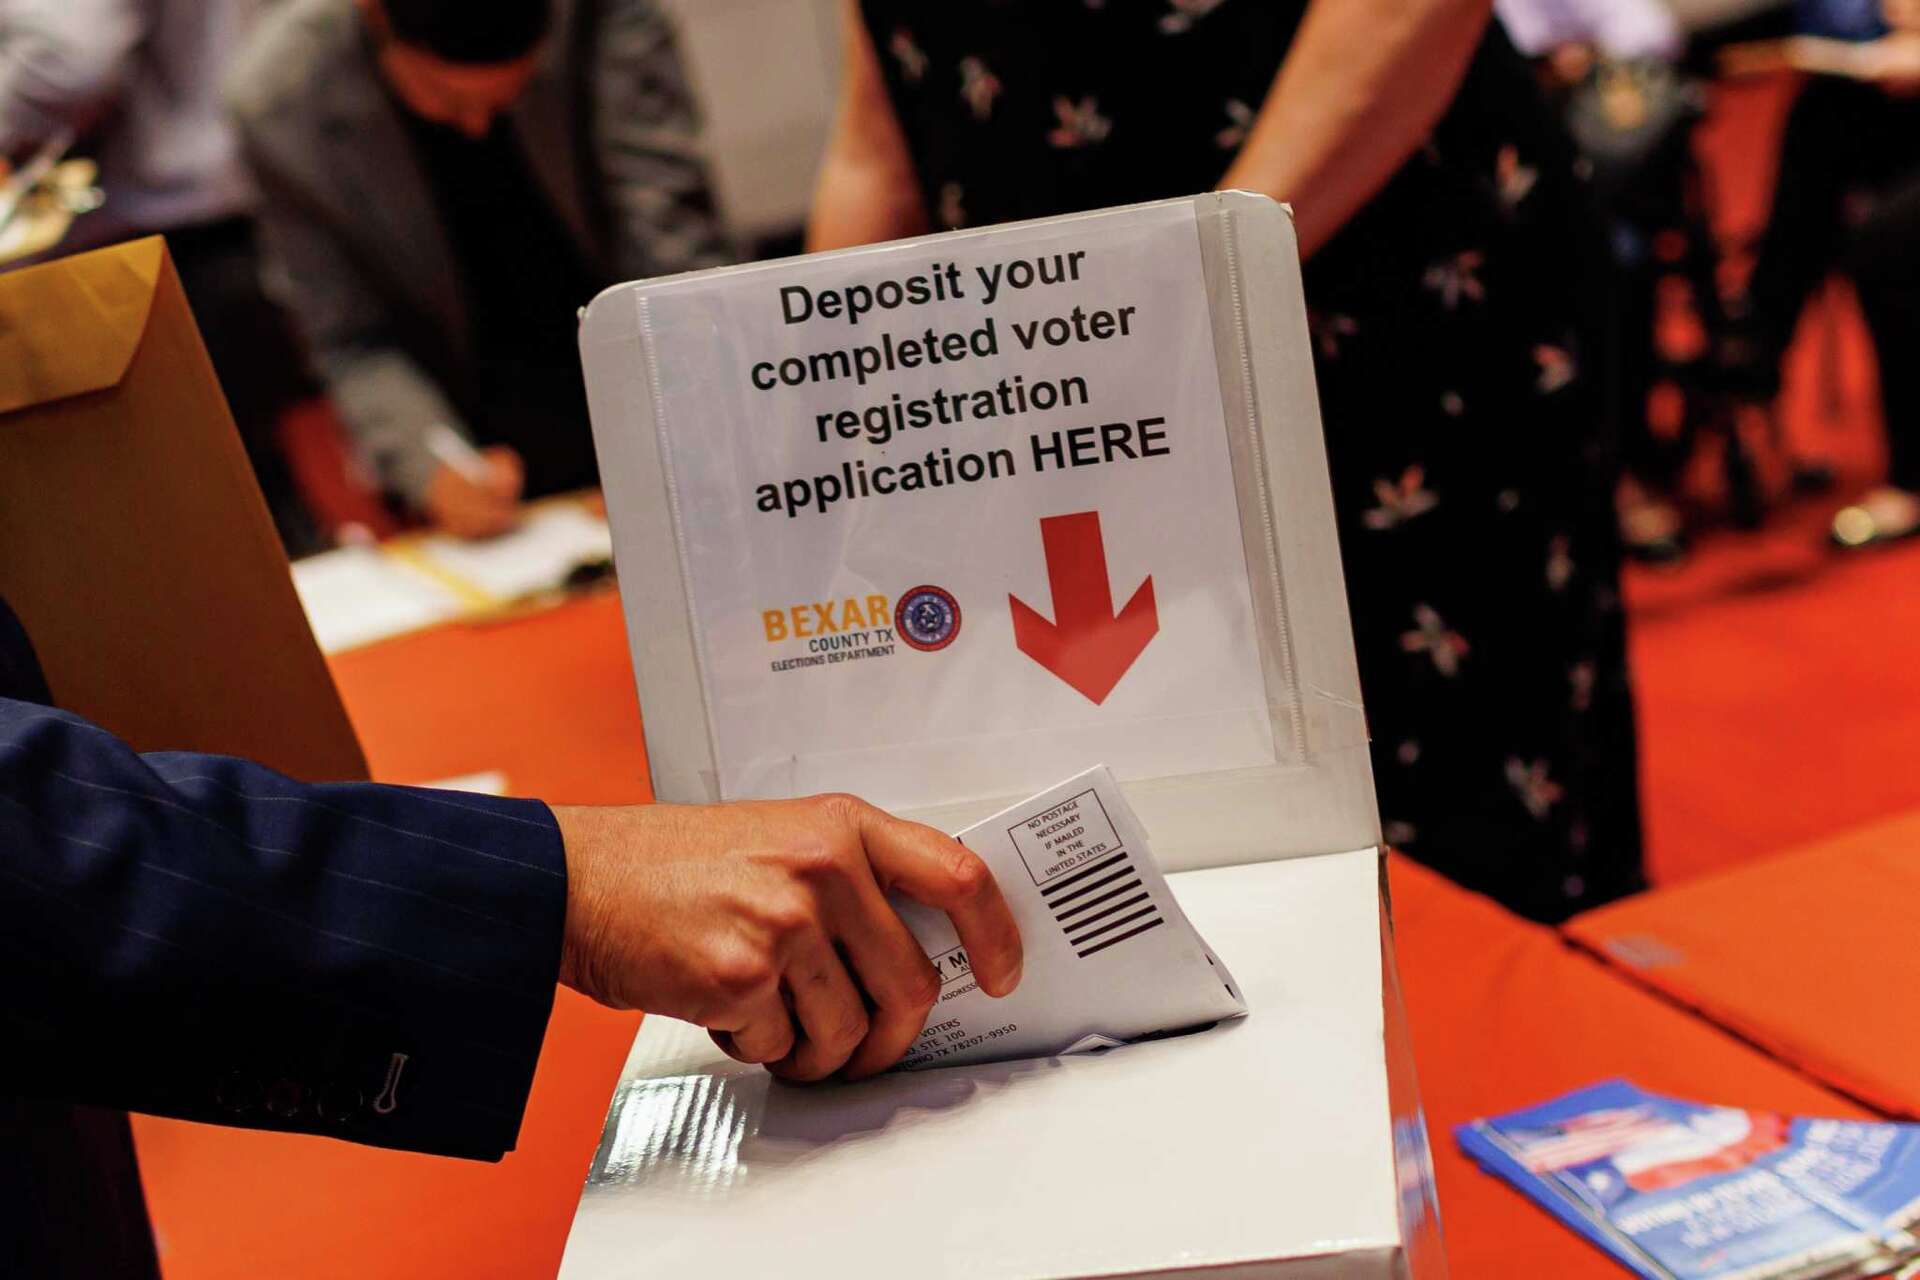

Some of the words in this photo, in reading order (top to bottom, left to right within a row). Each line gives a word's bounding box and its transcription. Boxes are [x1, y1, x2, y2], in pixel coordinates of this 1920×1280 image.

[780, 262, 964, 325] Deposit
[976, 250, 1086, 305] your
[751, 318, 999, 390] completed
[1012, 305, 1136, 351] voter
[816, 375, 1089, 445] registration
[756, 447, 1016, 518] application
[1031, 417, 1171, 472] HERE
[762, 594, 892, 643] BEXAR
[809, 632, 870, 653] COUNTY
[875, 628, 895, 643] TX
[771, 654, 826, 672] ELECTIONS
[827, 645, 896, 664] DEPARTMENT
[1027, 818, 1041, 830] NO
[1041, 800, 1079, 823] POSTAGE
[1035, 813, 1081, 840] NECESSARY
[1045, 841, 1052, 850] IF
[1054, 826, 1085, 845] MAILED
[1056, 849, 1066, 857] IN
[1067, 840, 1084, 853] THE
[1045, 857, 1076, 876] UNITED
[1076, 842, 1107, 862] STATES
[945, 1029, 966, 1042] 100
[951, 1023, 1017, 1052] 78207-9950
